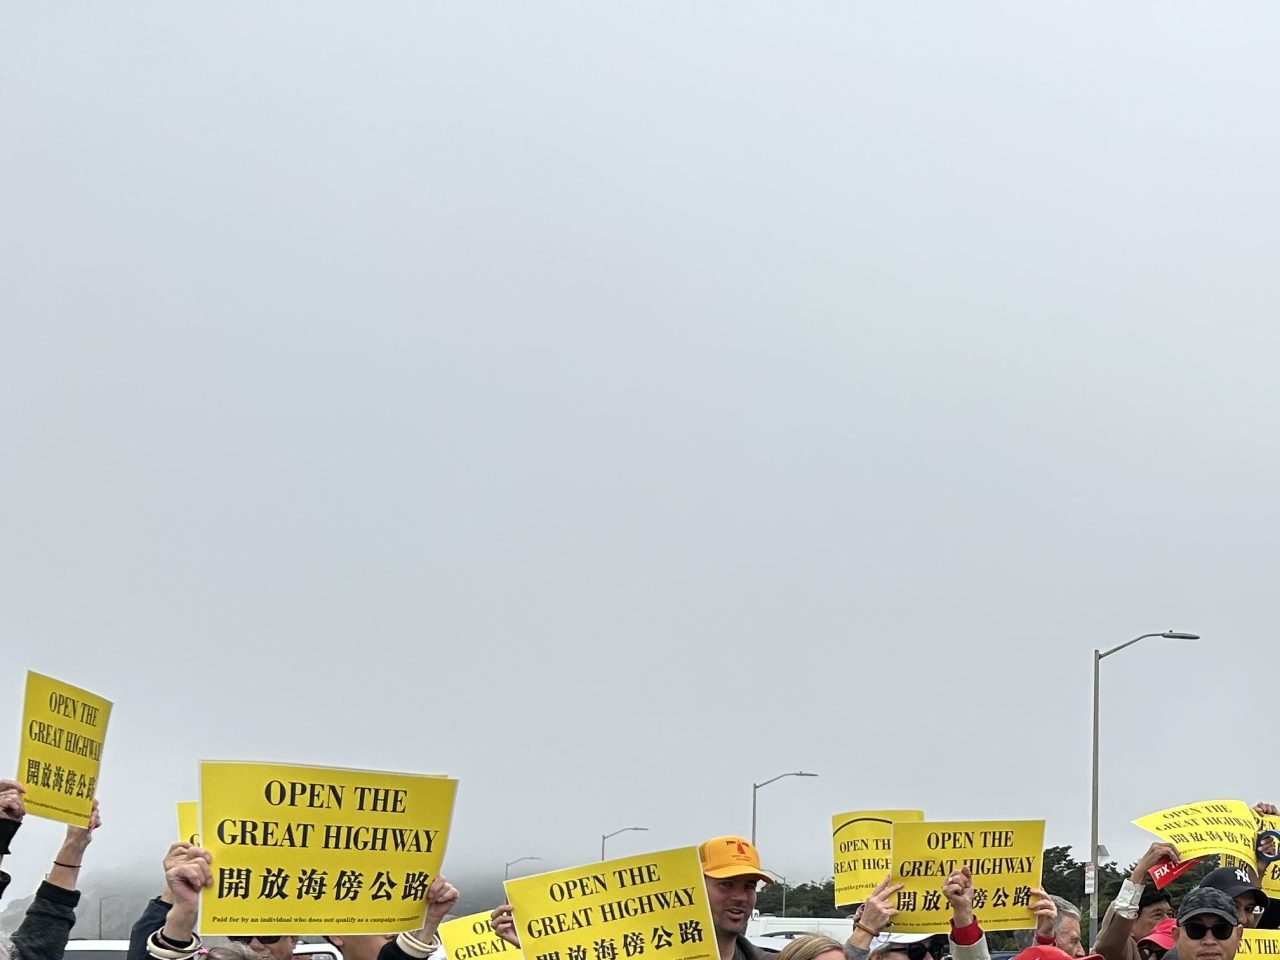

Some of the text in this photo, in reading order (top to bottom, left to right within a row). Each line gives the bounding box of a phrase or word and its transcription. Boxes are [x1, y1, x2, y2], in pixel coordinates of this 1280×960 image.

[49, 691, 99, 727] OPEN THE
[29, 719, 65, 749] GREAT
[265, 780, 408, 814] OPEN THE
[217, 818, 440, 853] GREAT HIGHWAY
[926, 830, 1014, 850] OPEN THE
[217, 867, 431, 902] 開放海傍公路
[549, 863, 661, 903] OPEN THE
[1153, 864, 1170, 880] FIX
[241, 916, 249, 924] by
[527, 886, 697, 939] GREAT HIGHWAY
